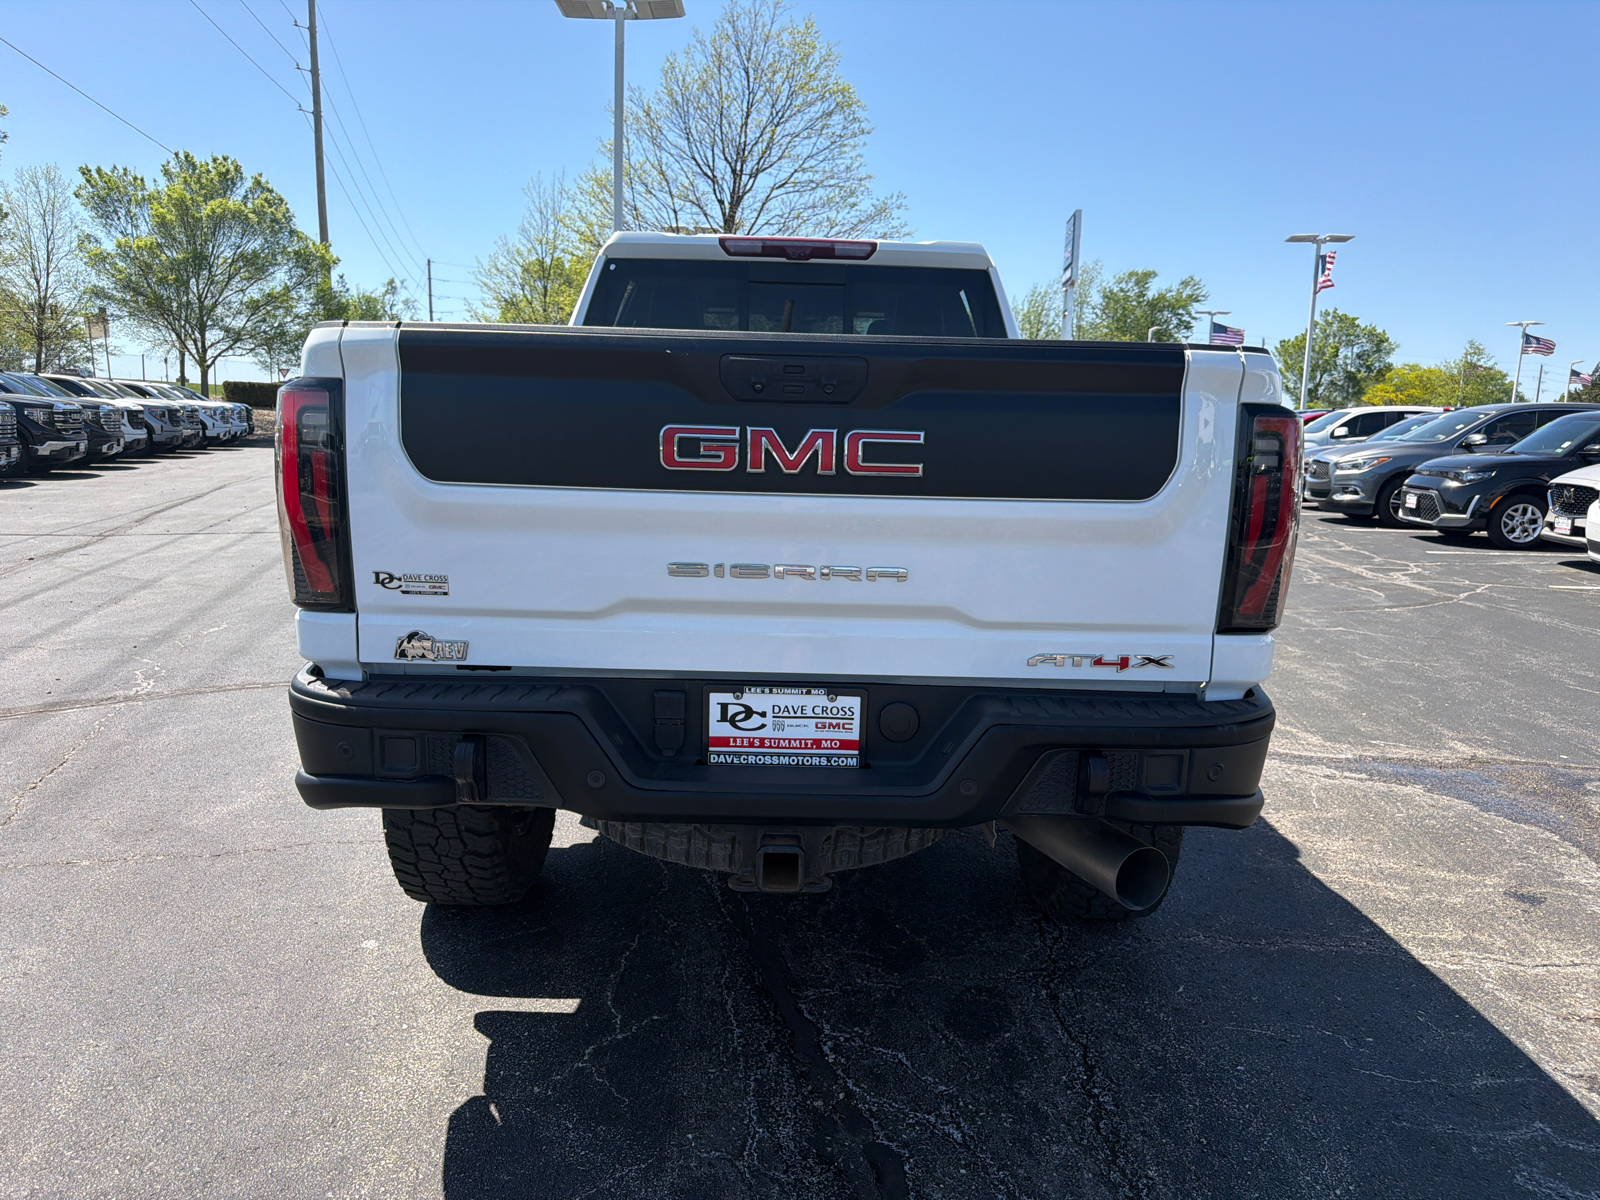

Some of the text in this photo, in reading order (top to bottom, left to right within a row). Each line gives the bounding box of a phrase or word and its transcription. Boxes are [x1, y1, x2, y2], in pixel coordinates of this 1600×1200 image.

[659, 424, 925, 477] GMC
[424, 574, 448, 582] CROSS
[667, 562, 908, 582] SIERRA
[434, 641, 466, 659] AEV
[1027, 653, 1175, 673] AT4X
[772, 687, 808, 695] SUMMIT
[772, 704, 855, 717] DAVE CROSS
[814, 722, 854, 731] GMC
[729, 737, 840, 749] LEE'S SUMMIT, MO
[710, 754, 857, 767] DAVECROSSMOTORS.COM
